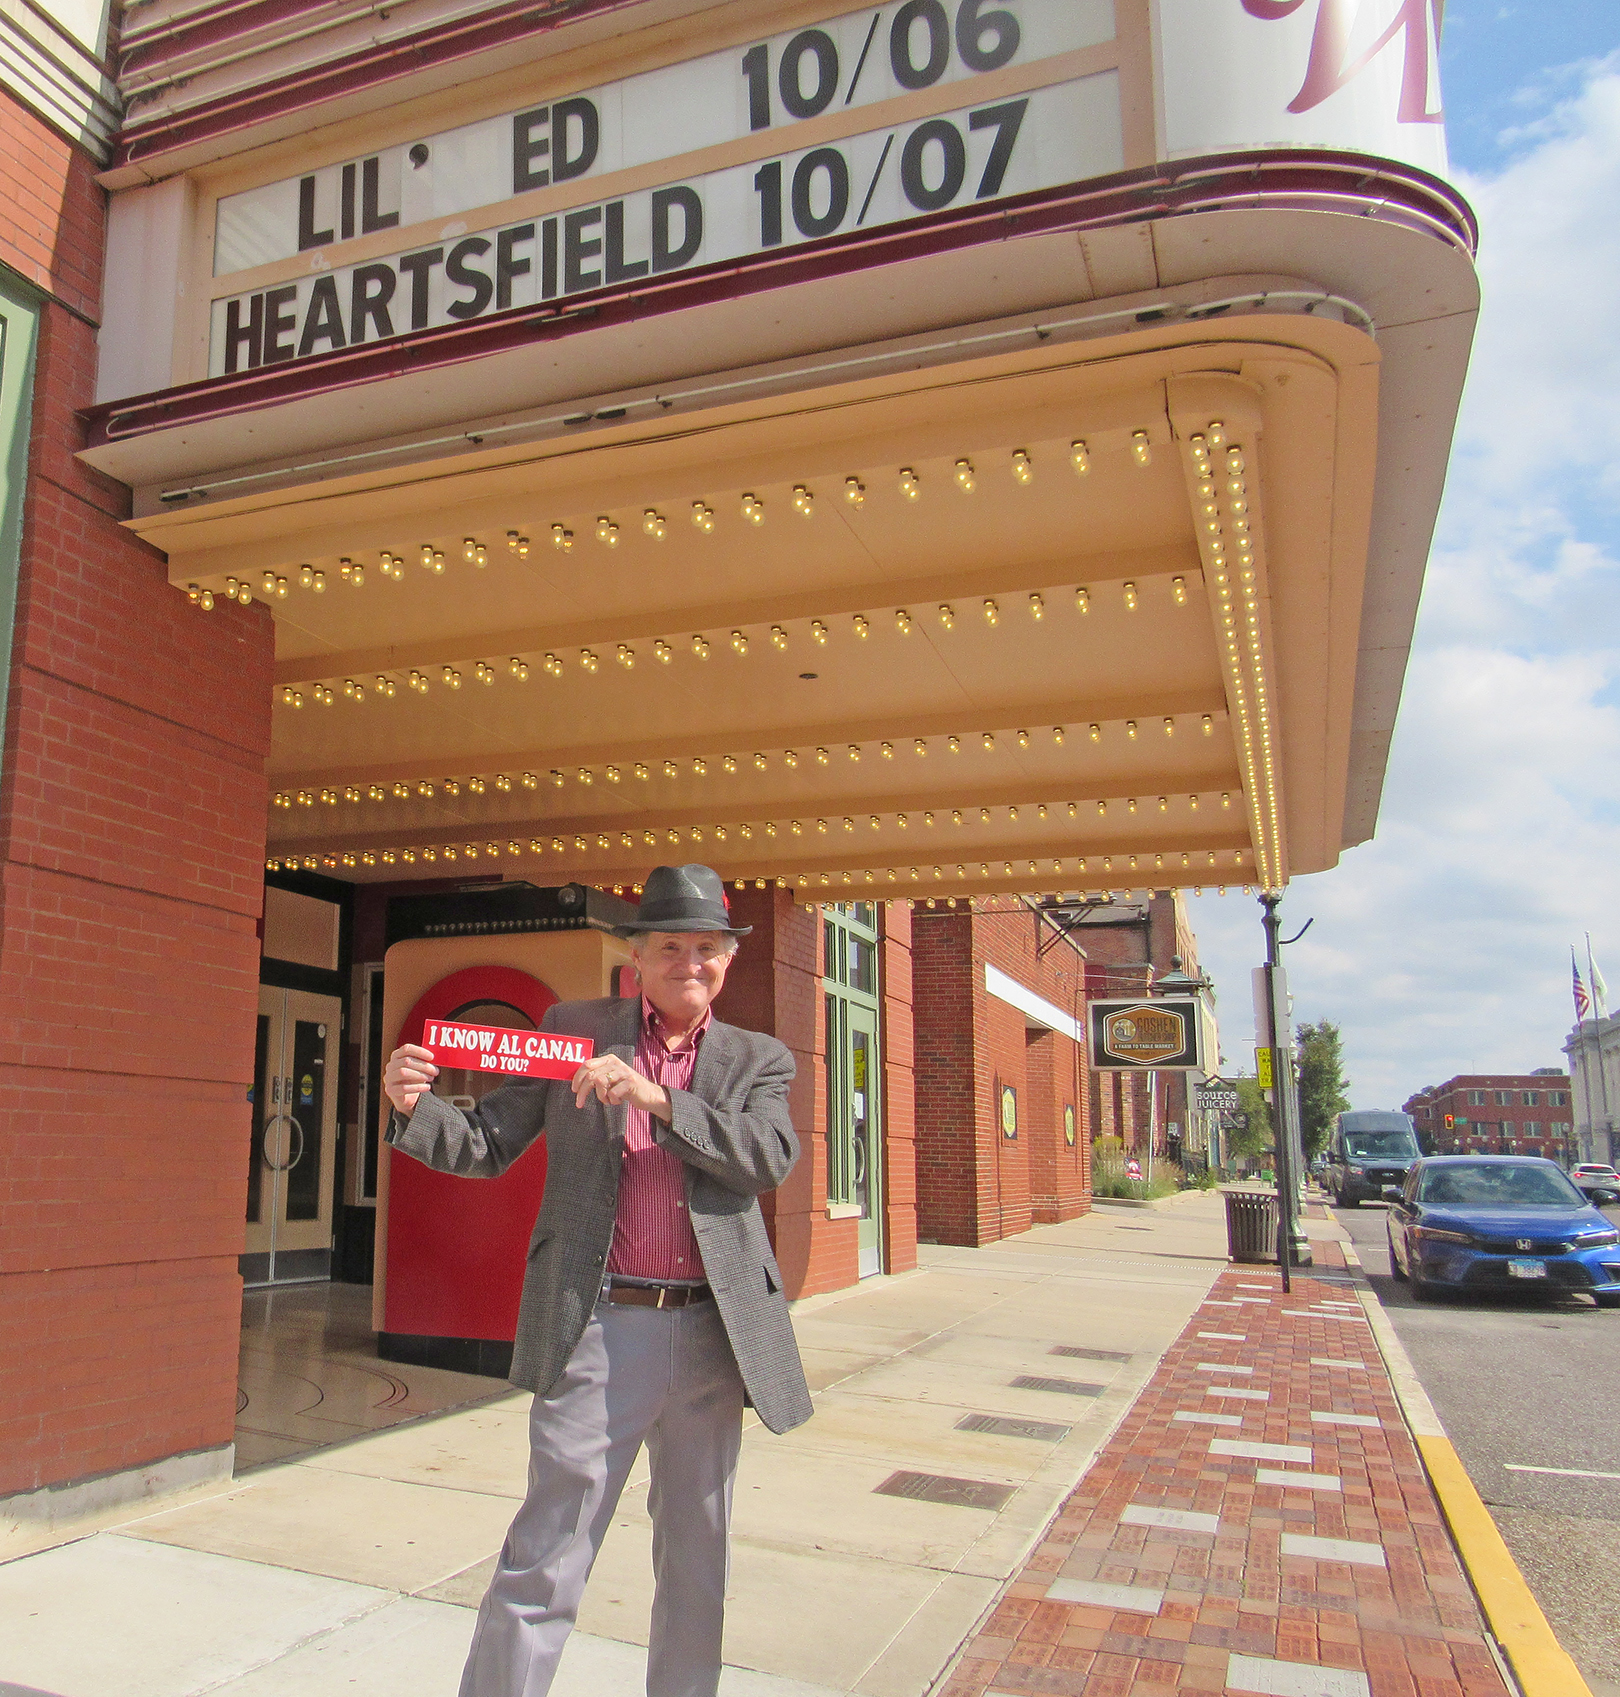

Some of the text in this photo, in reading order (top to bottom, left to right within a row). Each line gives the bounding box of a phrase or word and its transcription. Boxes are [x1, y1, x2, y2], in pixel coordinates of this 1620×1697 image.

[513, 98, 599, 195] ED
[741, 0, 1021, 131] 10/06
[224, 98, 1030, 375] HEARTSFIELD 10/07
[1137, 1017, 1176, 1033] GOSHEN
[429, 1025, 586, 1064] I KNOW AL CANAL
[480, 1053, 530, 1073] DO YOU?
[1196, 1091, 1237, 1100] source
[1197, 1099, 1237, 1109] JUICERY
